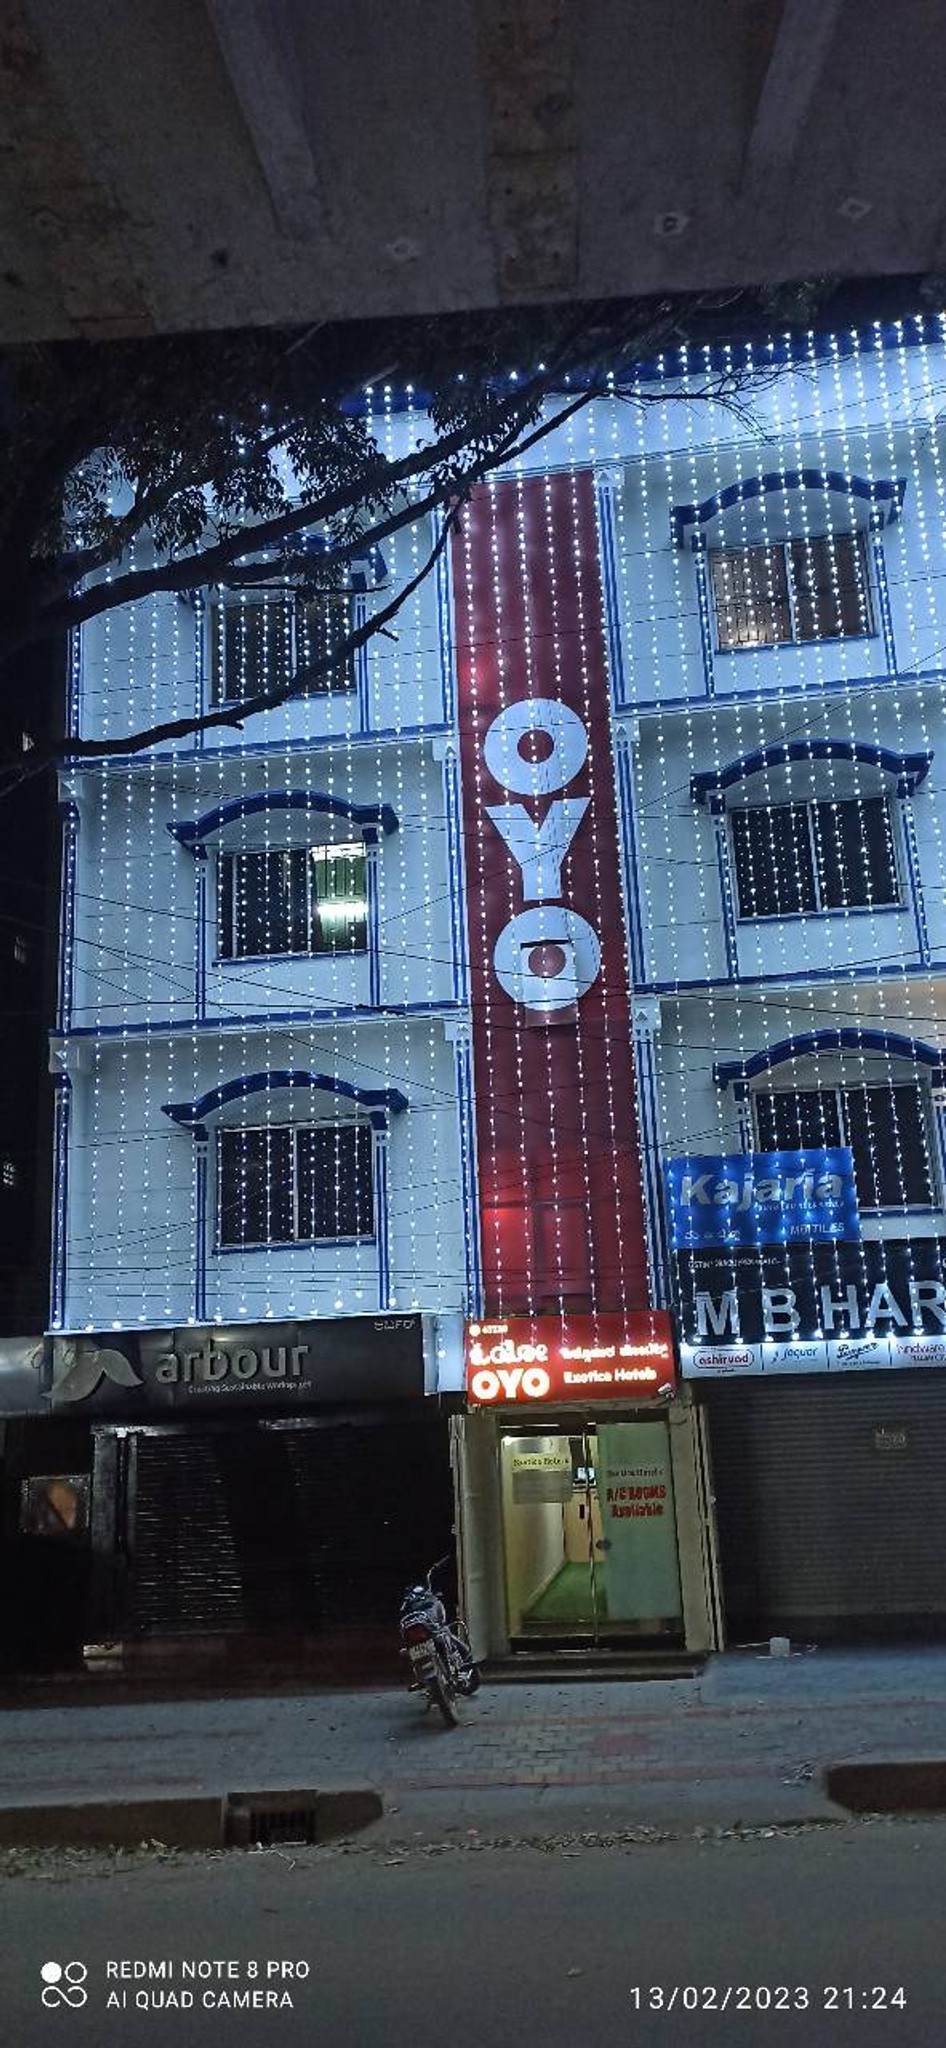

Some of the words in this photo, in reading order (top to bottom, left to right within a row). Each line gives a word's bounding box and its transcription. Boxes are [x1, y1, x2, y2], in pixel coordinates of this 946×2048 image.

[484, 698, 601, 1011] OYO
[680, 1168, 844, 1212] Kajaria
[696, 1289, 740, 1336] M
[762, 1287, 801, 1333] B
[154, 1340, 310, 1384] arbour
[563, 1370, 613, 1385] Exotica
[615, 1366, 658, 1382] Hotels
[699, 1353, 749, 1366] ashirvad
[471, 1367, 550, 1400] OYO
[628, 1484, 667, 1500] ROOMS
